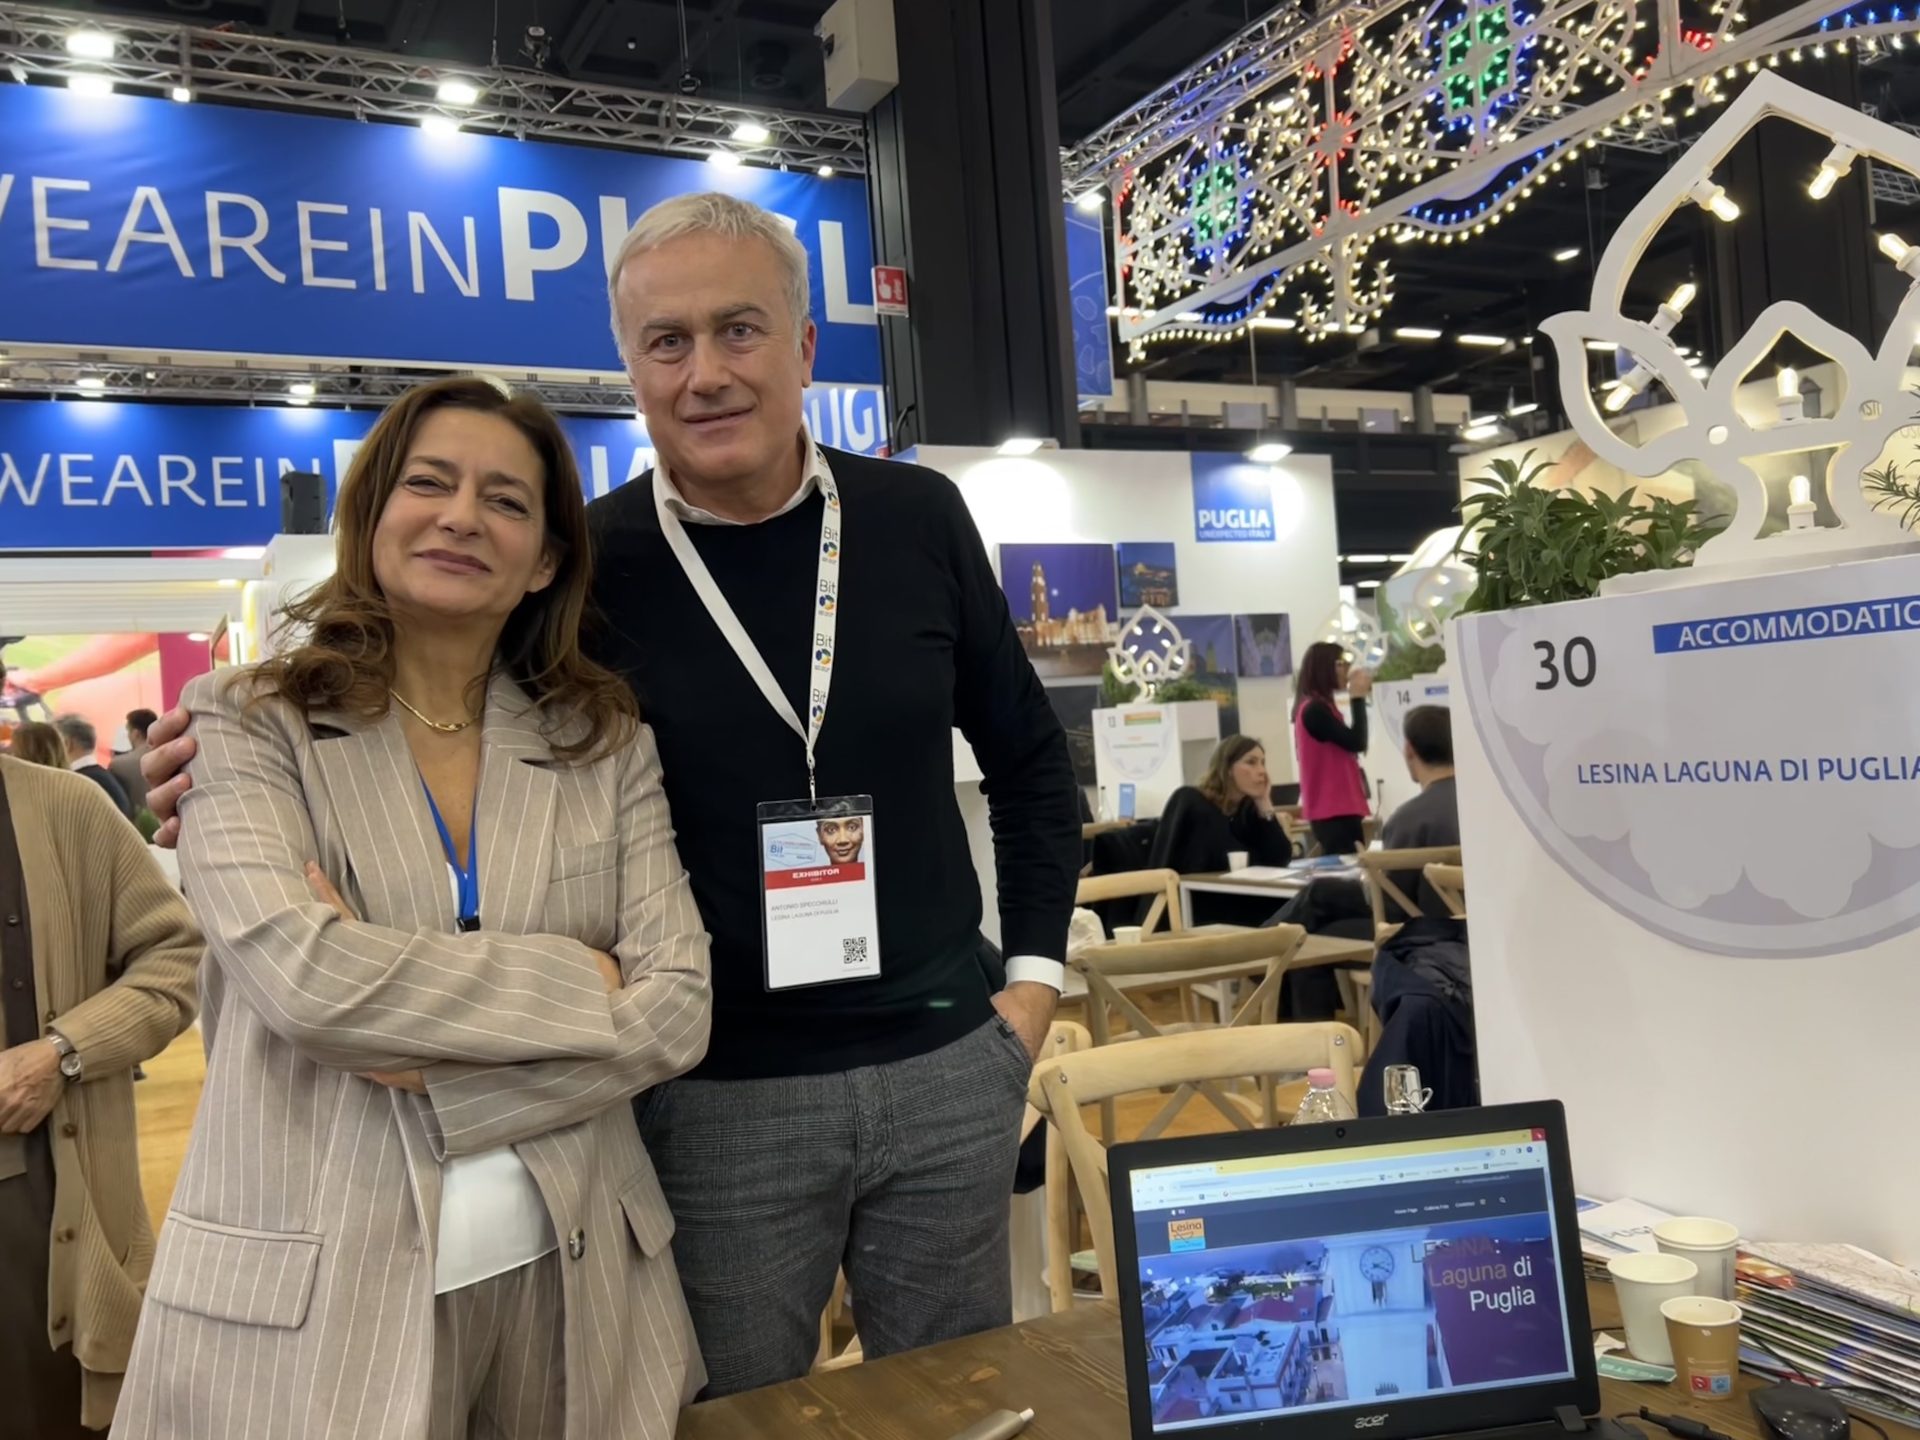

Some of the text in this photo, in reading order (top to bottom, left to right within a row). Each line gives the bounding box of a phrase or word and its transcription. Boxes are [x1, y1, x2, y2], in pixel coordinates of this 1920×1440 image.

[1198, 508, 1271, 529] PUGLIA
[823, 526, 839, 542] Bit
[819, 579, 837, 594] Bit
[815, 633, 833, 648] Bit
[1532, 635, 1597, 690] 30
[811, 688, 827, 703] Bit
[1397, 689, 1411, 705] 14
[1578, 763, 1658, 784] LESINA
[1664, 760, 1773, 784] LAGUNA
[1781, 758, 1809, 782] DI
[791, 868, 840, 879] EXHIBITOR
[1170, 1221, 1202, 1234] Lesina
[1410, 1235, 1501, 1263] LESINA:
[1429, 1256, 1533, 1289] Laguna di
[1470, 1286, 1536, 1313] Puglia
[1354, 1413, 1389, 1429] acer
